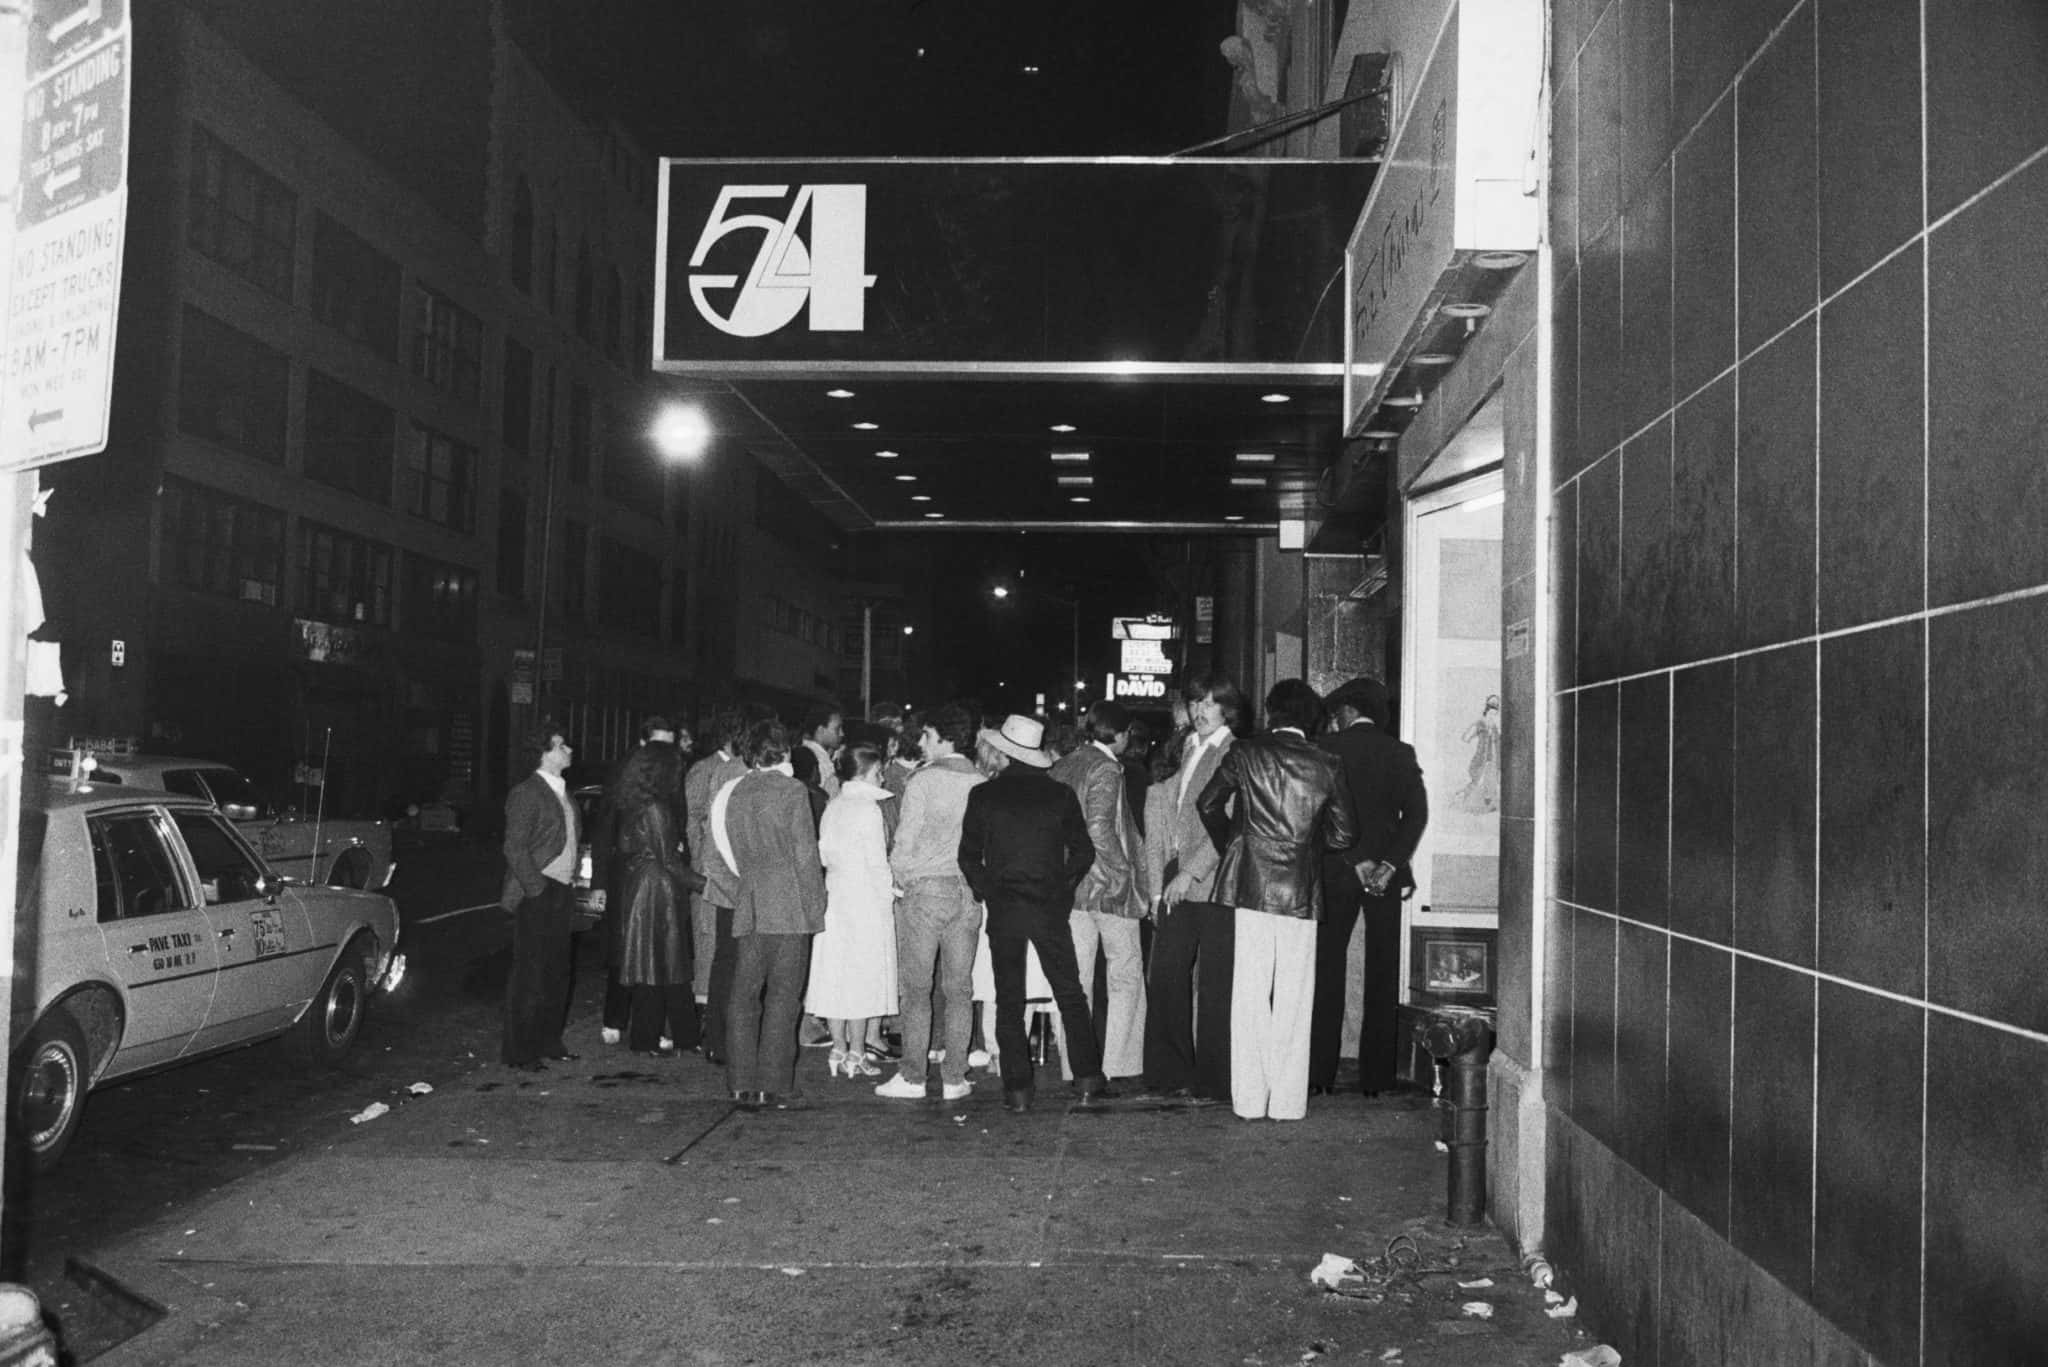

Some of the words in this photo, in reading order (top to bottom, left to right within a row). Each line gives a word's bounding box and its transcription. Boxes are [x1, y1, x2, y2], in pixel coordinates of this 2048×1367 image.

[53, 43, 120, 108] STANDING
[17, 249, 35, 281] NO
[41, 218, 114, 272] STANDING
[688, 183, 878, 337] 54
[12, 282, 57, 318] EXCEPT
[62, 261, 114, 301] TRUCKS
[1116, 679, 1166, 697] DAVID
[171, 932, 192, 949] TAXI
